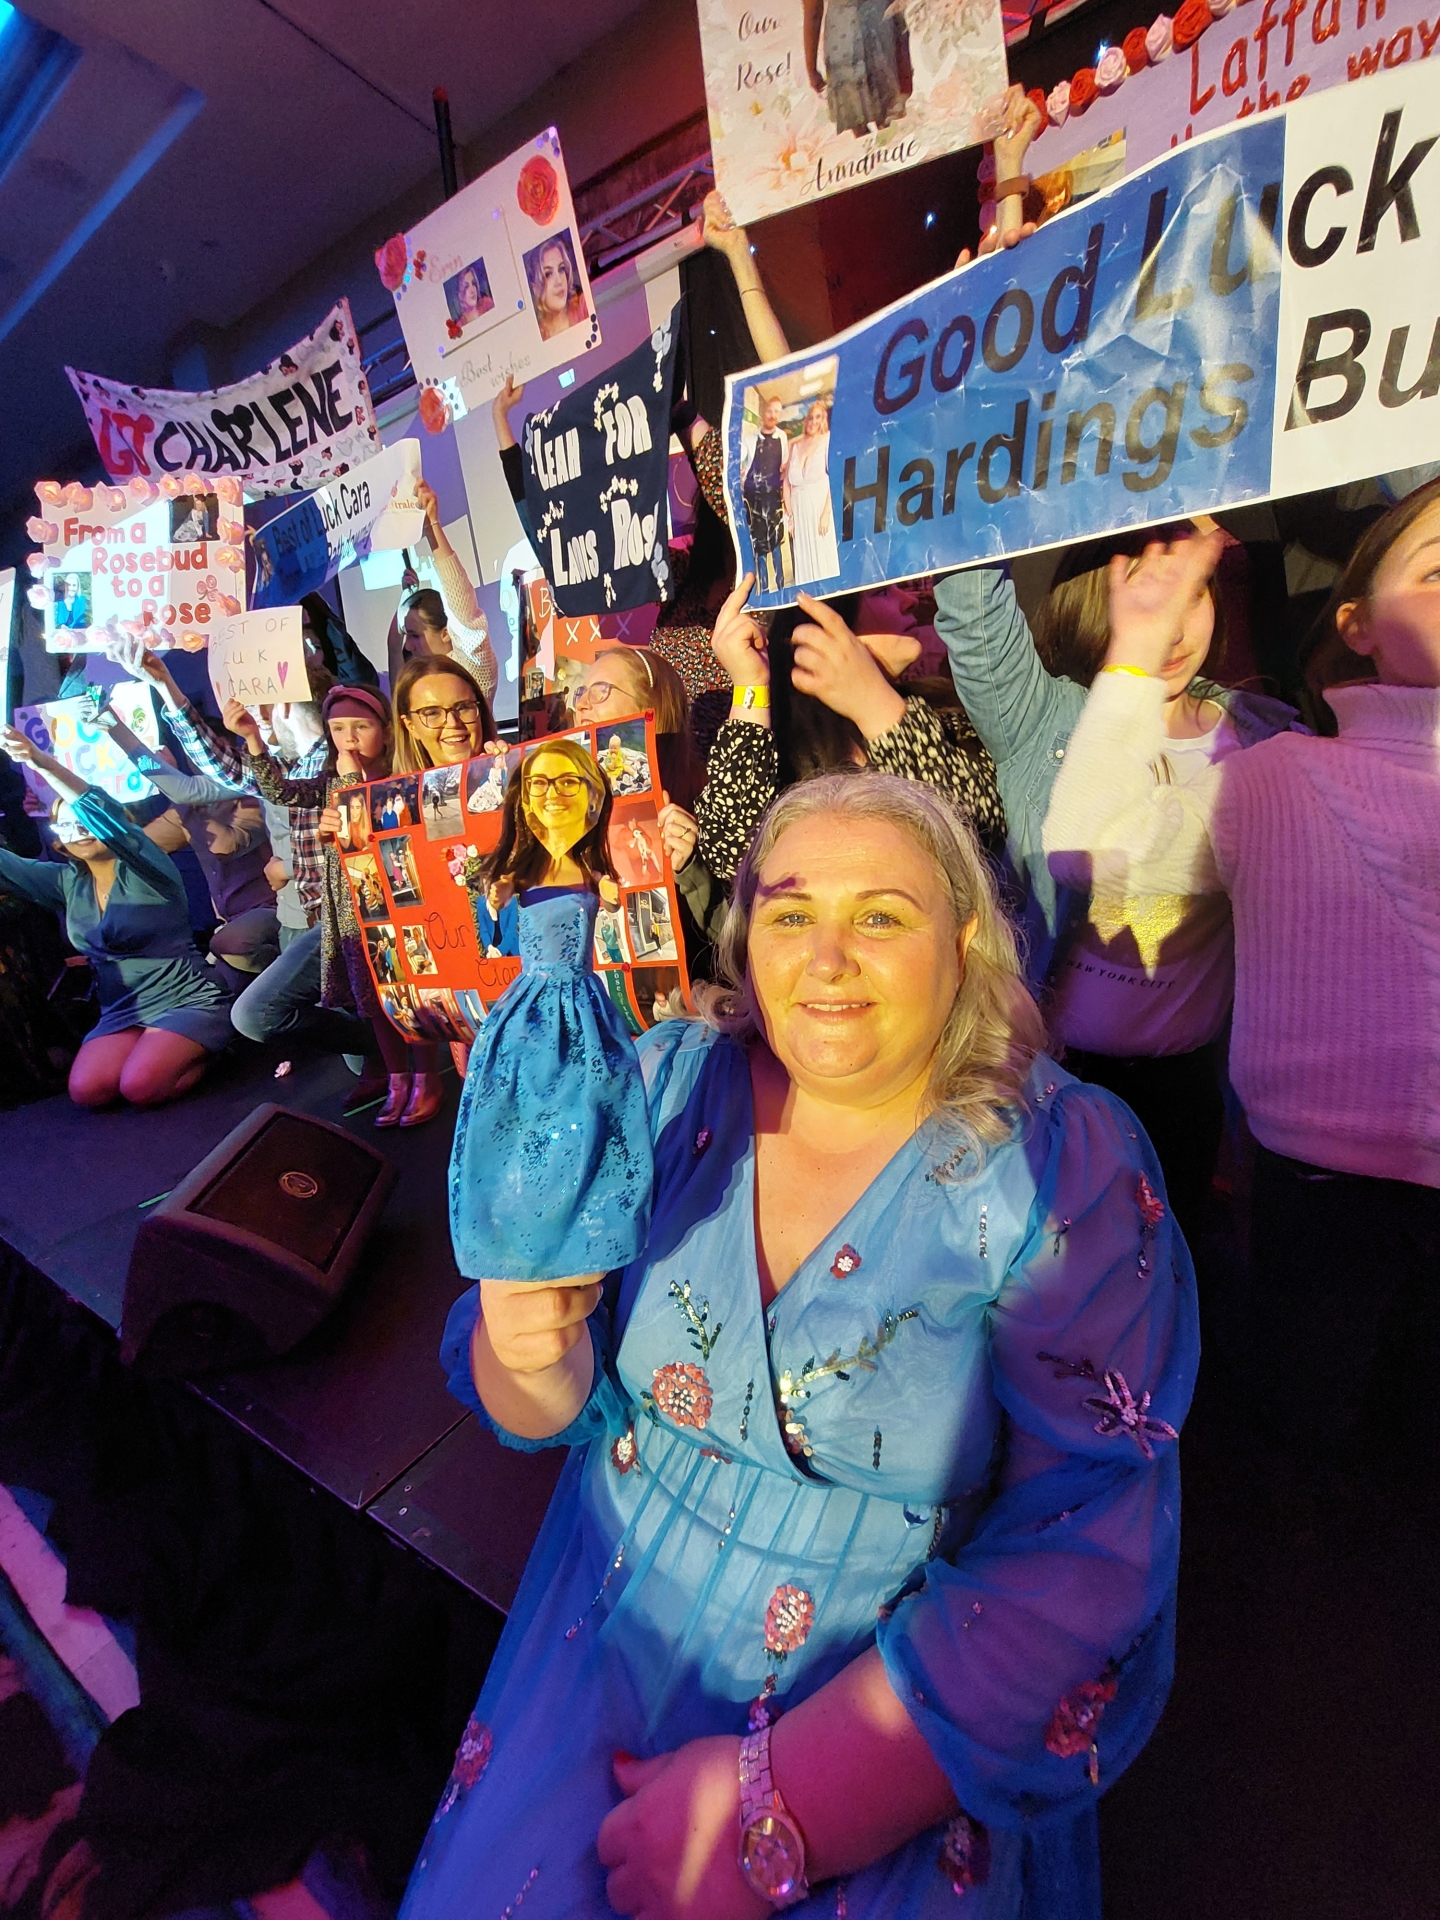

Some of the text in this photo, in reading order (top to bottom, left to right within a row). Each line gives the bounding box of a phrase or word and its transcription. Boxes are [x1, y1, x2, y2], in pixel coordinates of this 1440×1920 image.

[738, 10, 781, 41] Our
[737, 52, 791, 91] Rose!
[873, 104, 1440, 416] Good Luck
[154, 360, 353, 474] CHARLENE
[534, 395, 653, 491] LEAH FOR
[841, 362, 1255, 542] Hardings
[340, 481, 371, 520] Cara
[63, 517, 146, 546] From a
[92, 542, 208, 576] Rosebud
[111, 574, 165, 598] to a
[141, 599, 211, 627] Rose
[265, 616, 290, 633] OF
[425, 911, 471, 950] Our
[1099, 968, 1136, 985] YORK
[1139, 978, 1176, 990] CITY
